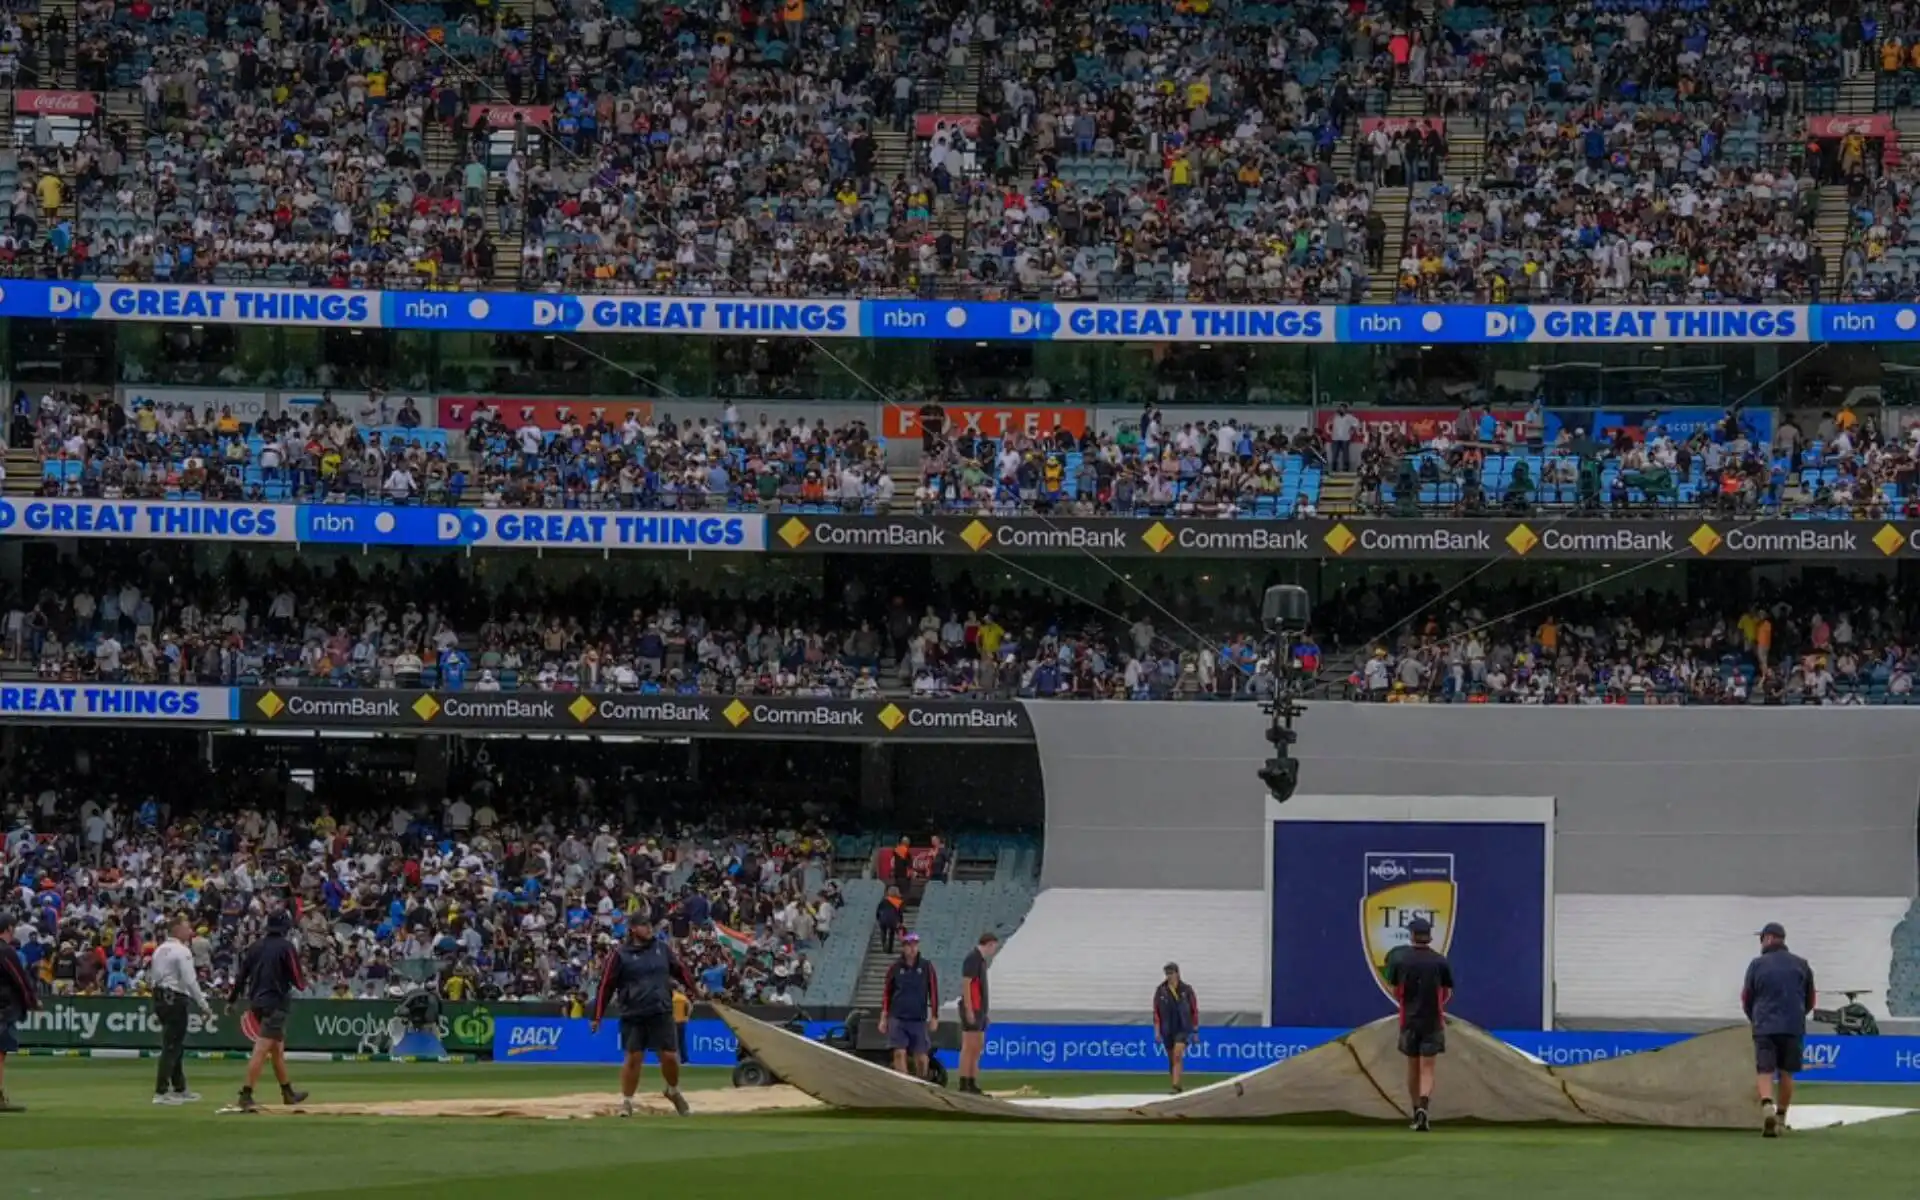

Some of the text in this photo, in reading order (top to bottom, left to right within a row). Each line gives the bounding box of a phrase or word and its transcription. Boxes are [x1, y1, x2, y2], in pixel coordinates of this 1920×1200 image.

[109, 288, 225, 316] GREAT
[234, 291, 369, 321] THINGS
[405, 298, 447, 319] nbn
[592, 301, 707, 330] GREAT
[714, 302, 847, 332] THINGS
[883, 308, 926, 328] nbn
[1069, 308, 1183, 335] GREAT
[1190, 309, 1323, 338] THINGS
[1360, 312, 1401, 332] nbn
[1544, 310, 1657, 338] GREAT
[1663, 310, 1797, 338] THINGS
[1832, 311, 1875, 331] nbn
[25, 503, 138, 533] GREAT
[146, 505, 276, 535] THINGS
[313, 512, 354, 532] nbn
[438, 512, 744, 545] DO GREAT THINGS
[815, 522, 945, 547] CommBank
[997, 525, 1126, 548] CommBank
[1179, 528, 1308, 550] CommBank
[1360, 529, 1490, 551] CommBank
[1543, 530, 1674, 551] CommBank
[1726, 530, 1857, 551] CommBank
[1, 687, 200, 715] REAT THINGS
[289, 696, 400, 717] CommBank
[444, 701, 555, 720] CommBank
[600, 701, 711, 722] CommBank
[753, 704, 864, 726] CommBank
[908, 707, 1018, 729] CommBank
[1378, 905, 1441, 929] TEST
[15, 1004, 219, 1039] unity cricet
[314, 1011, 450, 1038] Woolws
[508, 1026, 563, 1045] RACV
[692, 1035, 741, 1052] Insu
[985, 1036, 1056, 1063] elping
[1063, 1039, 1147, 1062] protect
[1152, 1038, 1211, 1058] wat
[1538, 1044, 1607, 1064] Home
[1802, 1044, 1841, 1064] ACV
[1895, 1049, 1920, 1069] He
